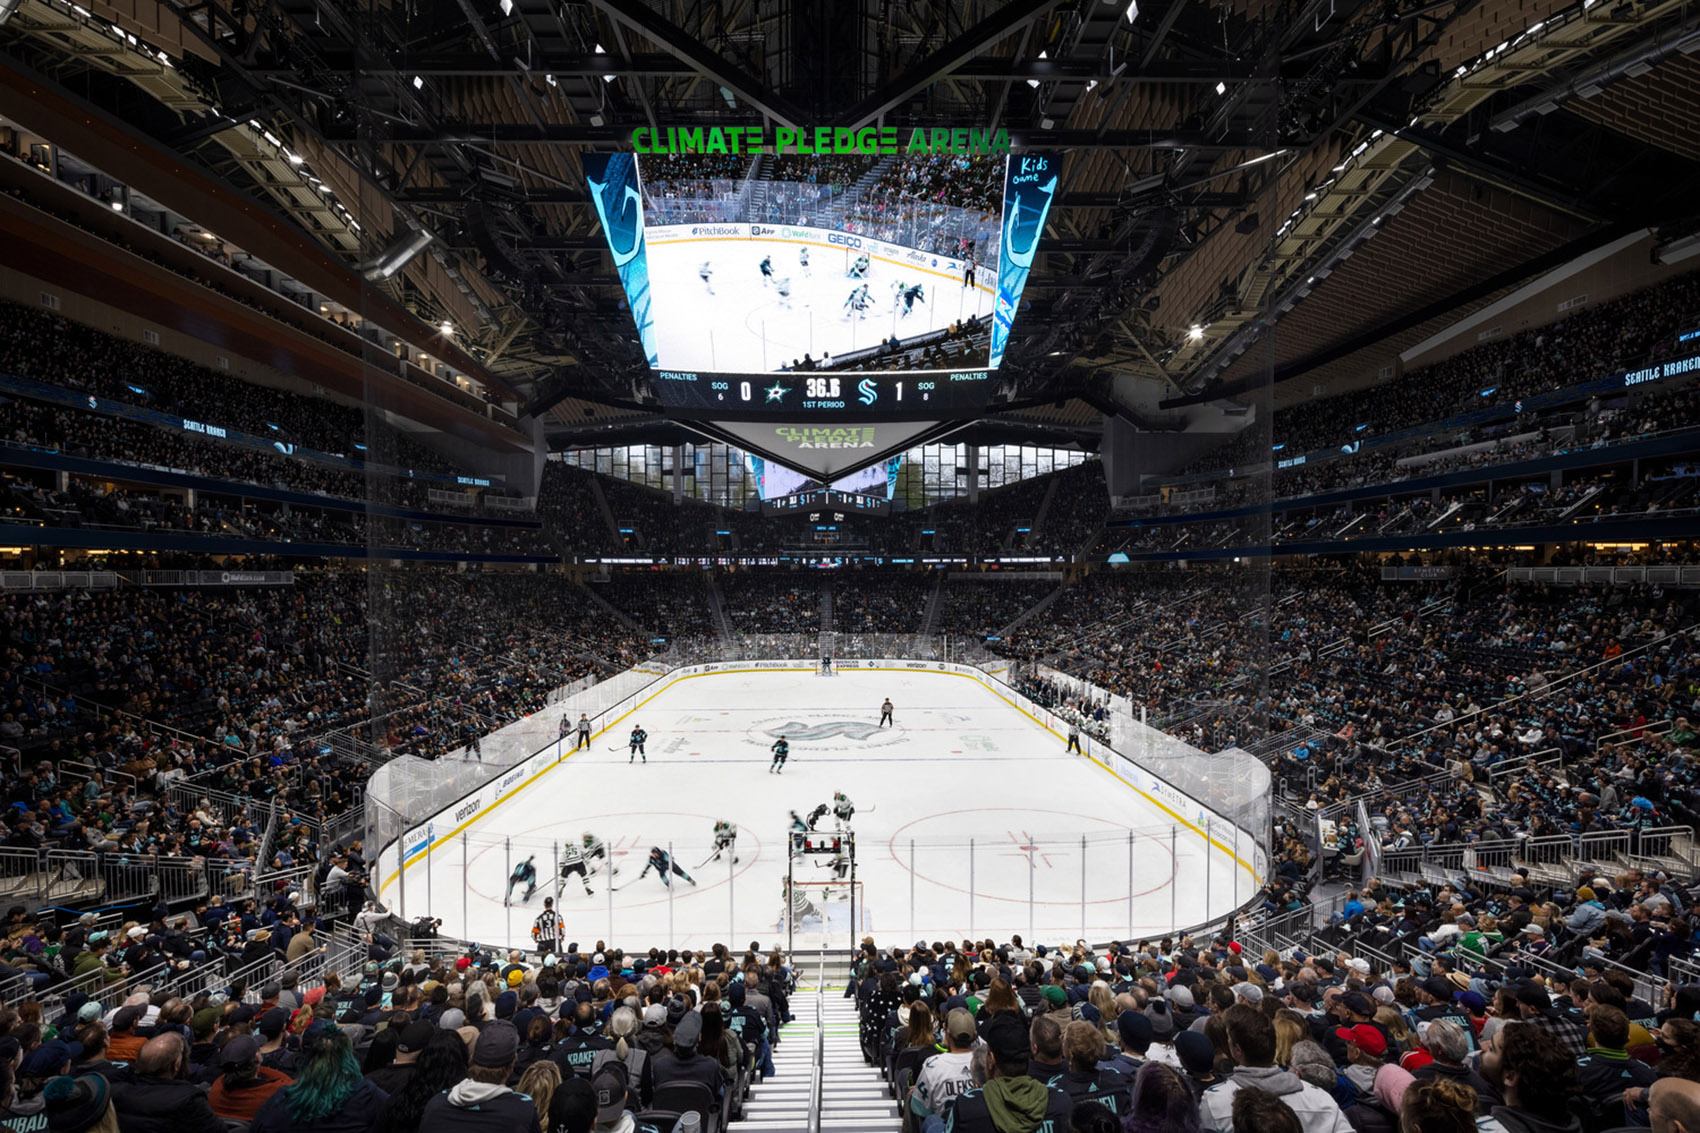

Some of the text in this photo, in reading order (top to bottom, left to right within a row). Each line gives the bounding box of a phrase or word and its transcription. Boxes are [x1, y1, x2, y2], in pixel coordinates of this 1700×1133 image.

[632, 127, 1011, 154] CLIMATE PLEDGE ARENA
[1021, 157, 1048, 174] Kids
[700, 227, 739, 235] PitchBook
[828, 233, 862, 248] GEICO
[1625, 356, 1700, 386] SEATTLE KRAKEN
[660, 372, 697, 381] PENALTIES
[950, 372, 987, 381] PENALTIES
[712, 382, 728, 390] SOG
[918, 382, 934, 390] SOG
[740, 382, 751, 401] 0
[895, 382, 903, 401] 1
[717, 393, 724, 401] 6
[818, 401, 845, 409] PERIOD
[455, 799, 480, 823] verizon
[546, 920, 554, 928] 3
